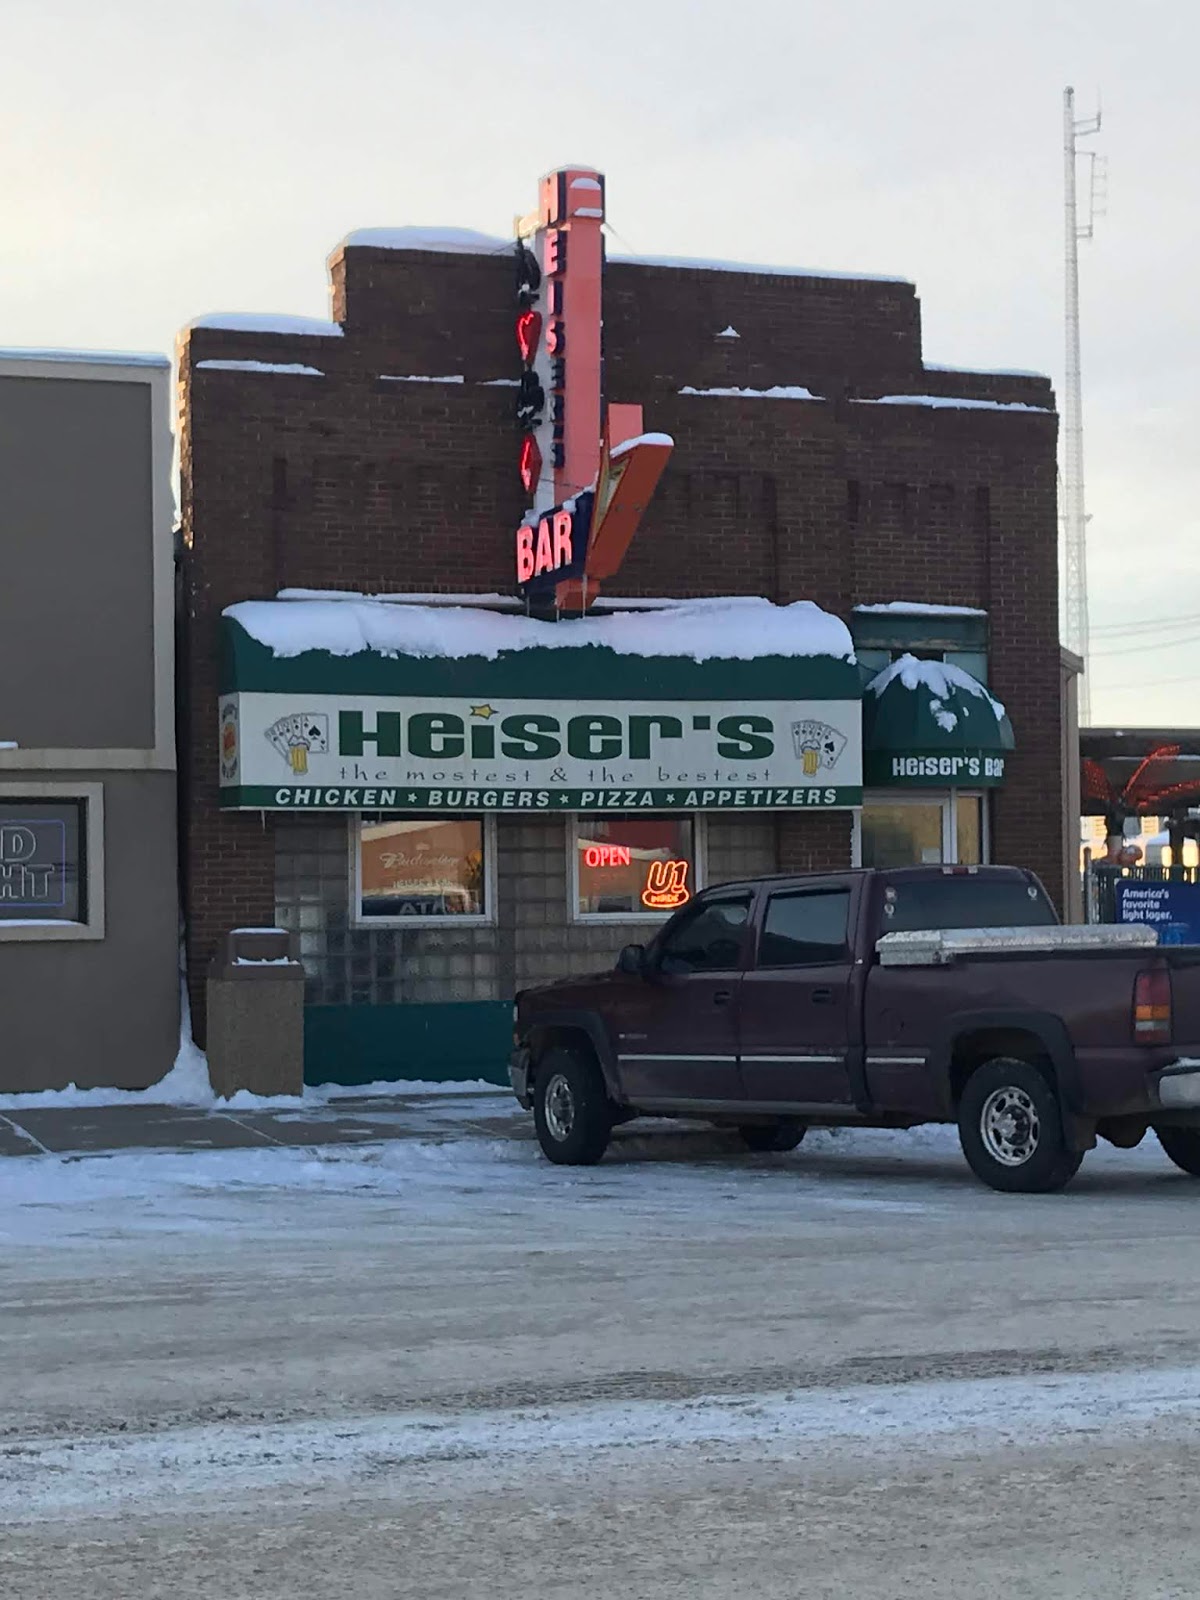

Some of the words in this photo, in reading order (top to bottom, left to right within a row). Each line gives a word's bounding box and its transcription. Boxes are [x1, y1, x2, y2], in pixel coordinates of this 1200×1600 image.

[517, 511, 572, 583] BAR
[340, 764, 387, 782] the
[406, 767, 531, 782] mostest
[549, 767, 569, 782] &
[587, 767, 635, 783] the
[658, 767, 772, 782] bestest
[275, 788, 397, 806] CHICKEN
[428, 790, 550, 807] BURGERS
[580, 790, 654, 806] PIZZA
[685, 788, 837, 806] APPETIZERS
[585, 847, 631, 867] OPEN
[1122, 888, 1170, 899] America's
[1122, 899, 1160, 909] favorite
[1122, 909, 1144, 921] light
[1145, 909, 1173, 922] lager.
